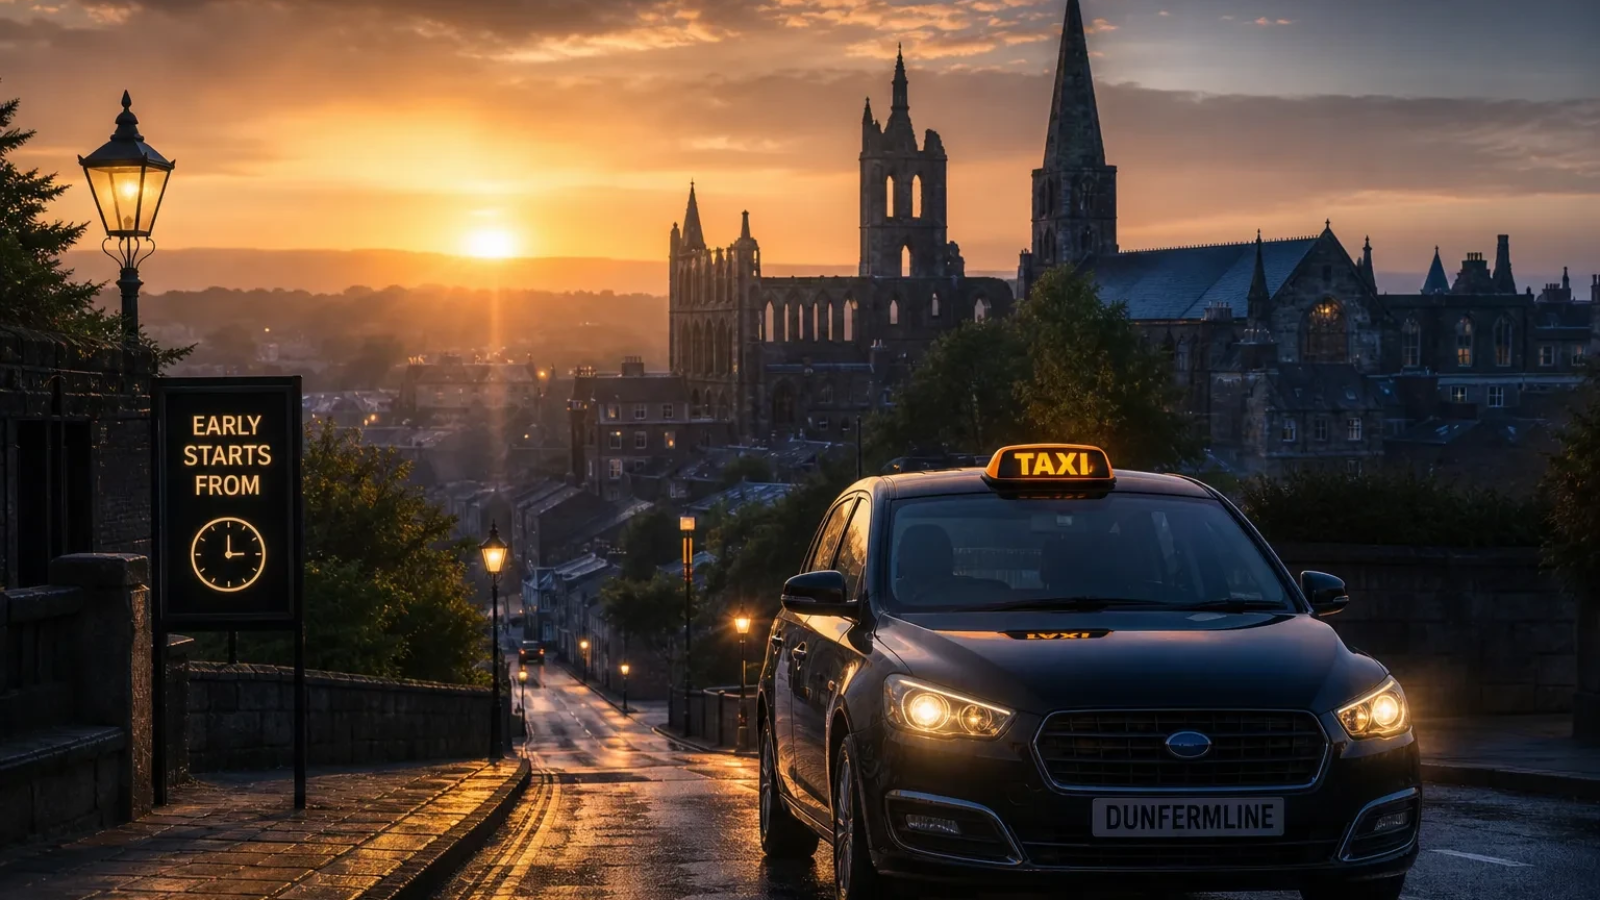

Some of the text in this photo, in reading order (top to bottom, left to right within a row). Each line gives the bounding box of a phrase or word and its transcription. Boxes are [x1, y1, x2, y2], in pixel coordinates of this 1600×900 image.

[193, 415, 262, 436] EARLY
[183, 444, 272, 466] STARTS
[1014, 452, 1090, 476] TAXI
[195, 474, 260, 496] FROM
[1105, 804, 1274, 830] DUNFERMLINE
